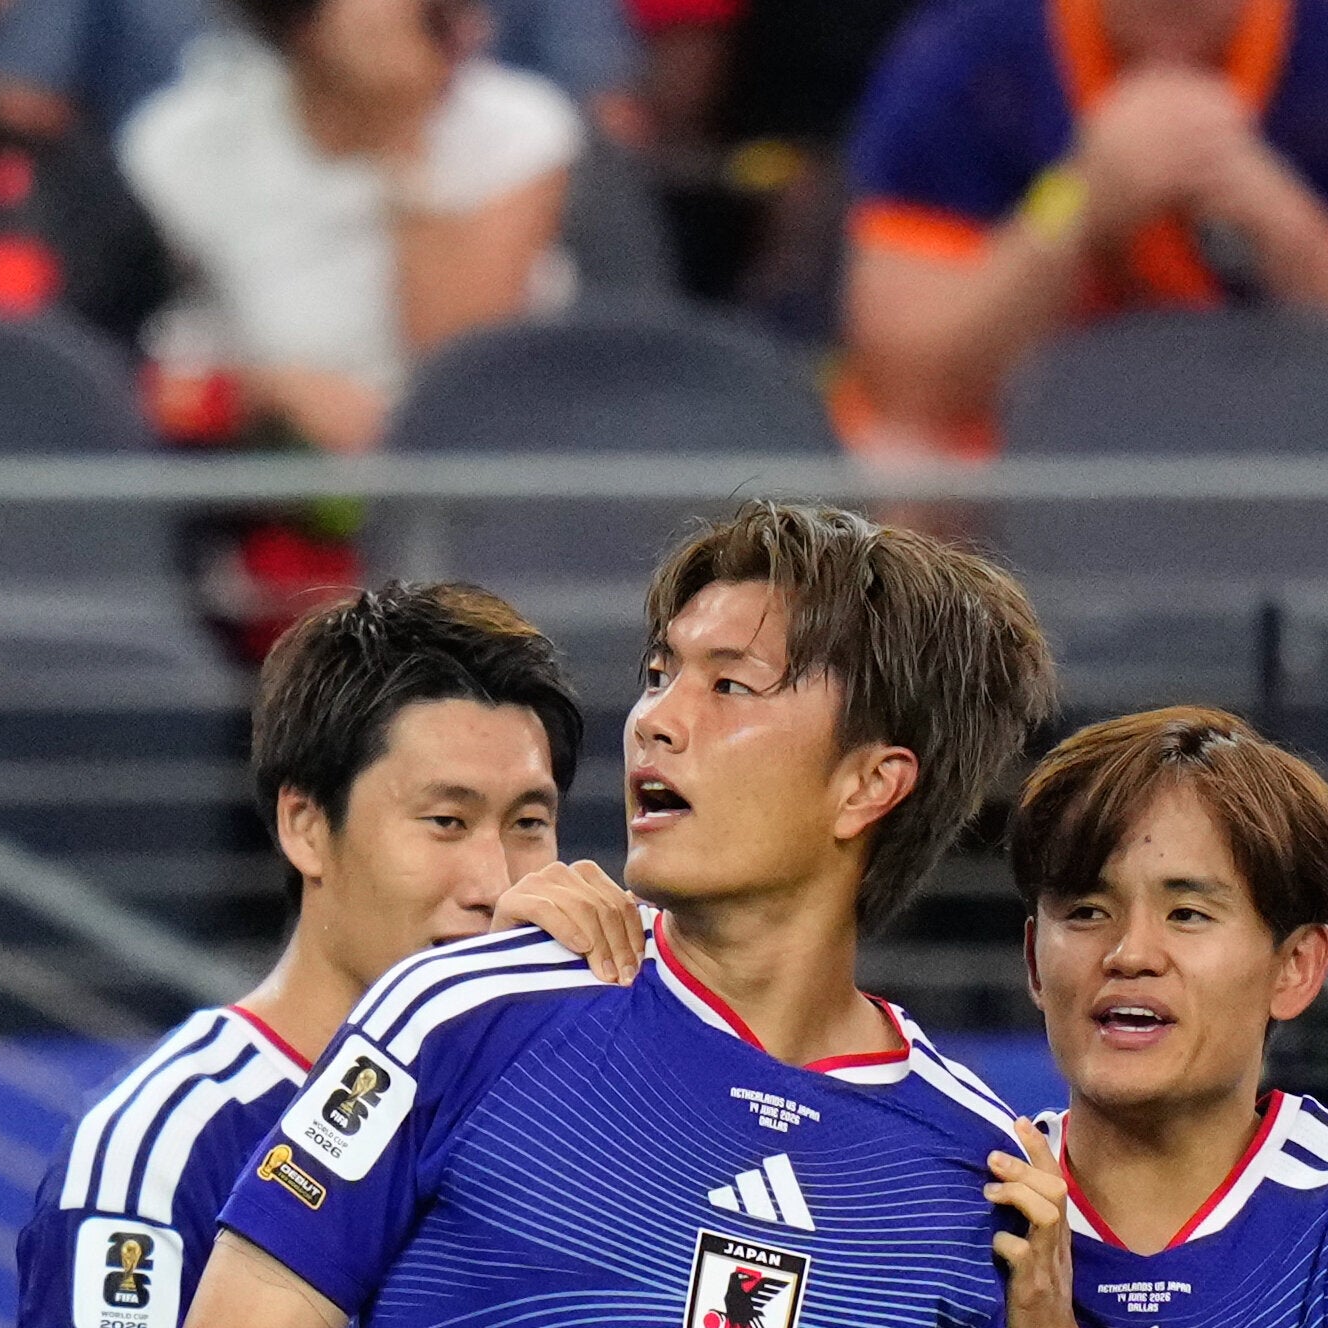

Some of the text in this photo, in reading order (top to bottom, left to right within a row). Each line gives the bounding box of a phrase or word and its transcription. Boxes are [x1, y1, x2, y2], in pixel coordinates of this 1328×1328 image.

[329, 1109, 350, 1129] FIFA
[759, 1115, 788, 1133] DALLAS
[779, 1109, 801, 1126] 2026
[304, 1127, 343, 1159] 2026
[312, 1119, 349, 1150] WORLD CUP
[280, 1164, 321, 1197] DEBUT
[724, 1243, 782, 1267] JAPAN
[114, 1292, 139, 1304] FIFA
[1149, 1292, 1171, 1302] 2026
[101, 1311, 149, 1321] WORLD CUP
[1127, 1303, 1159, 1312] DALLAS
